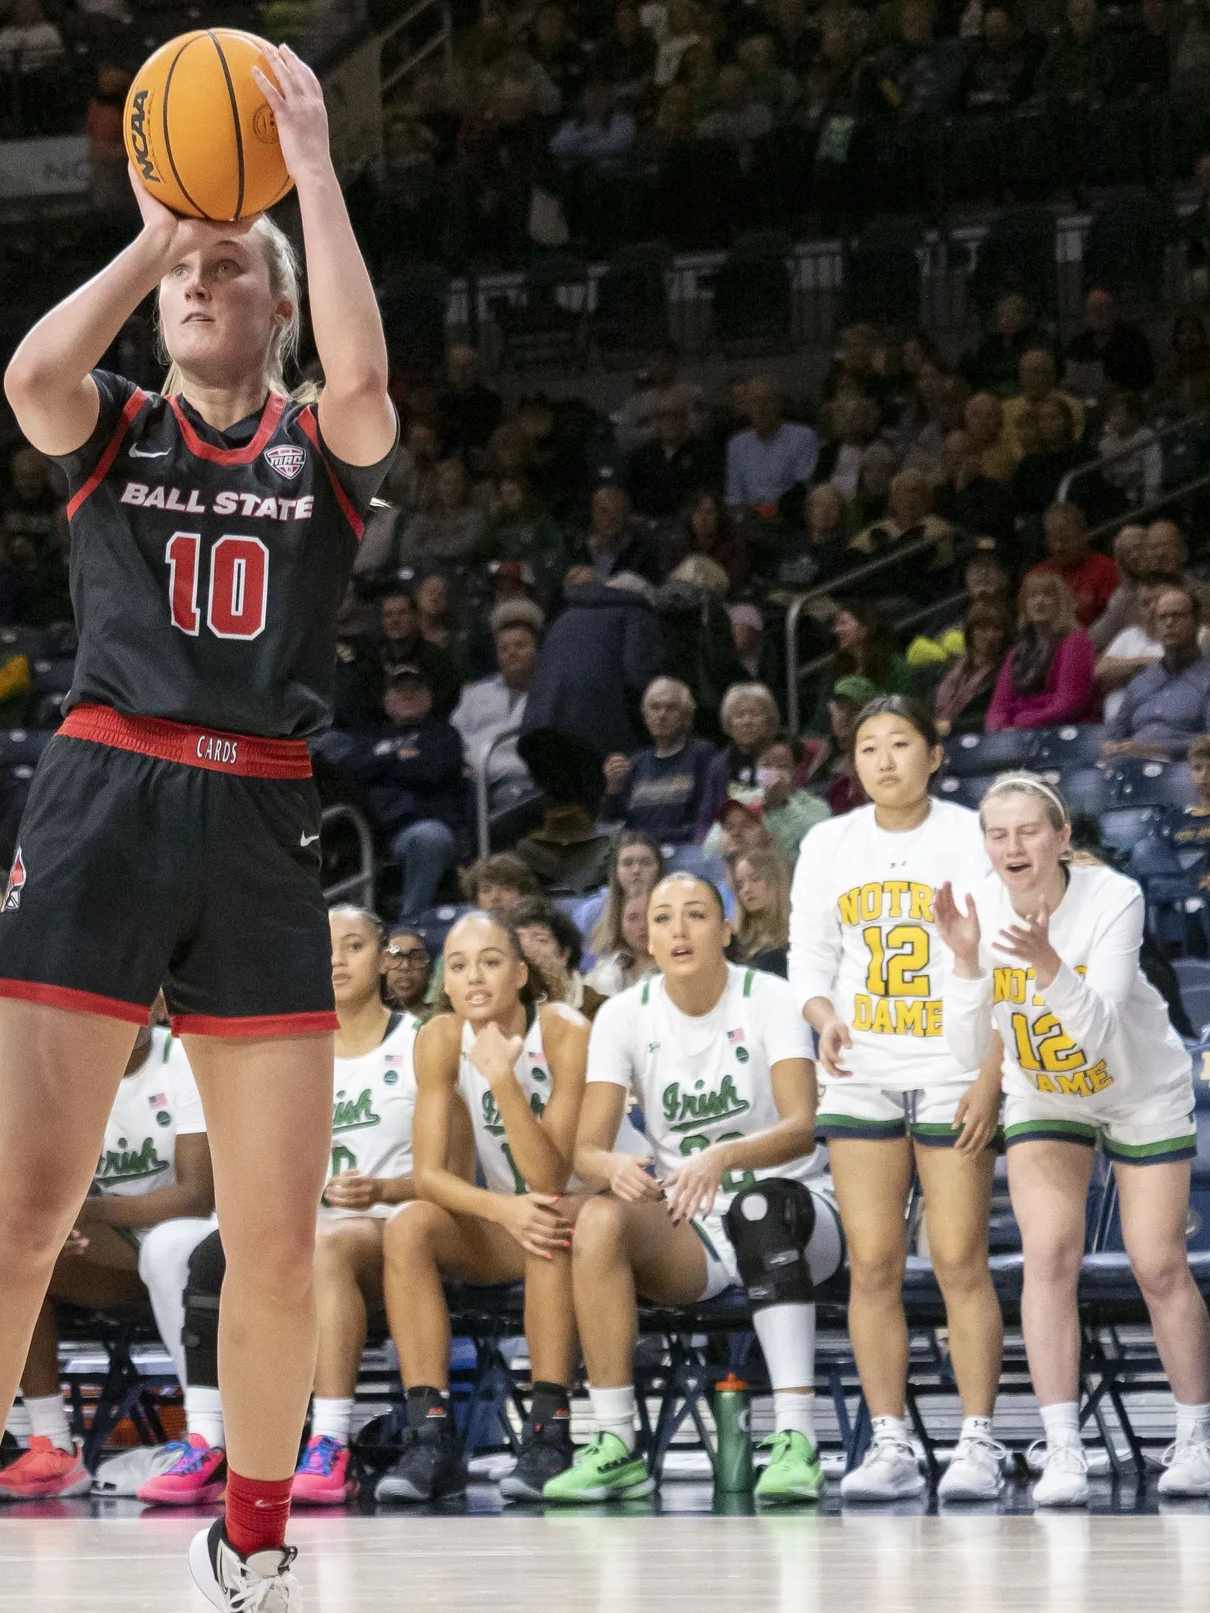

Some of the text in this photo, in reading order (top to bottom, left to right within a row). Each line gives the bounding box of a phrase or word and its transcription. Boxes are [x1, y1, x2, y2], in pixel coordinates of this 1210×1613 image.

[130, 89, 162, 183] NCAA
[270, 455, 305, 466] MAC
[120, 482, 315, 521] BALL STATE
[165, 531, 270, 641] 10
[196, 735, 238, 764] CARDS
[838, 880, 936, 927] NOTR
[862, 925, 931, 998] 12
[852, 992, 943, 1038] DAME
[1012, 1012, 1087, 1073] 12
[1035, 1059, 1114, 1098] AME
[662, 1074, 750, 1133] Irish
